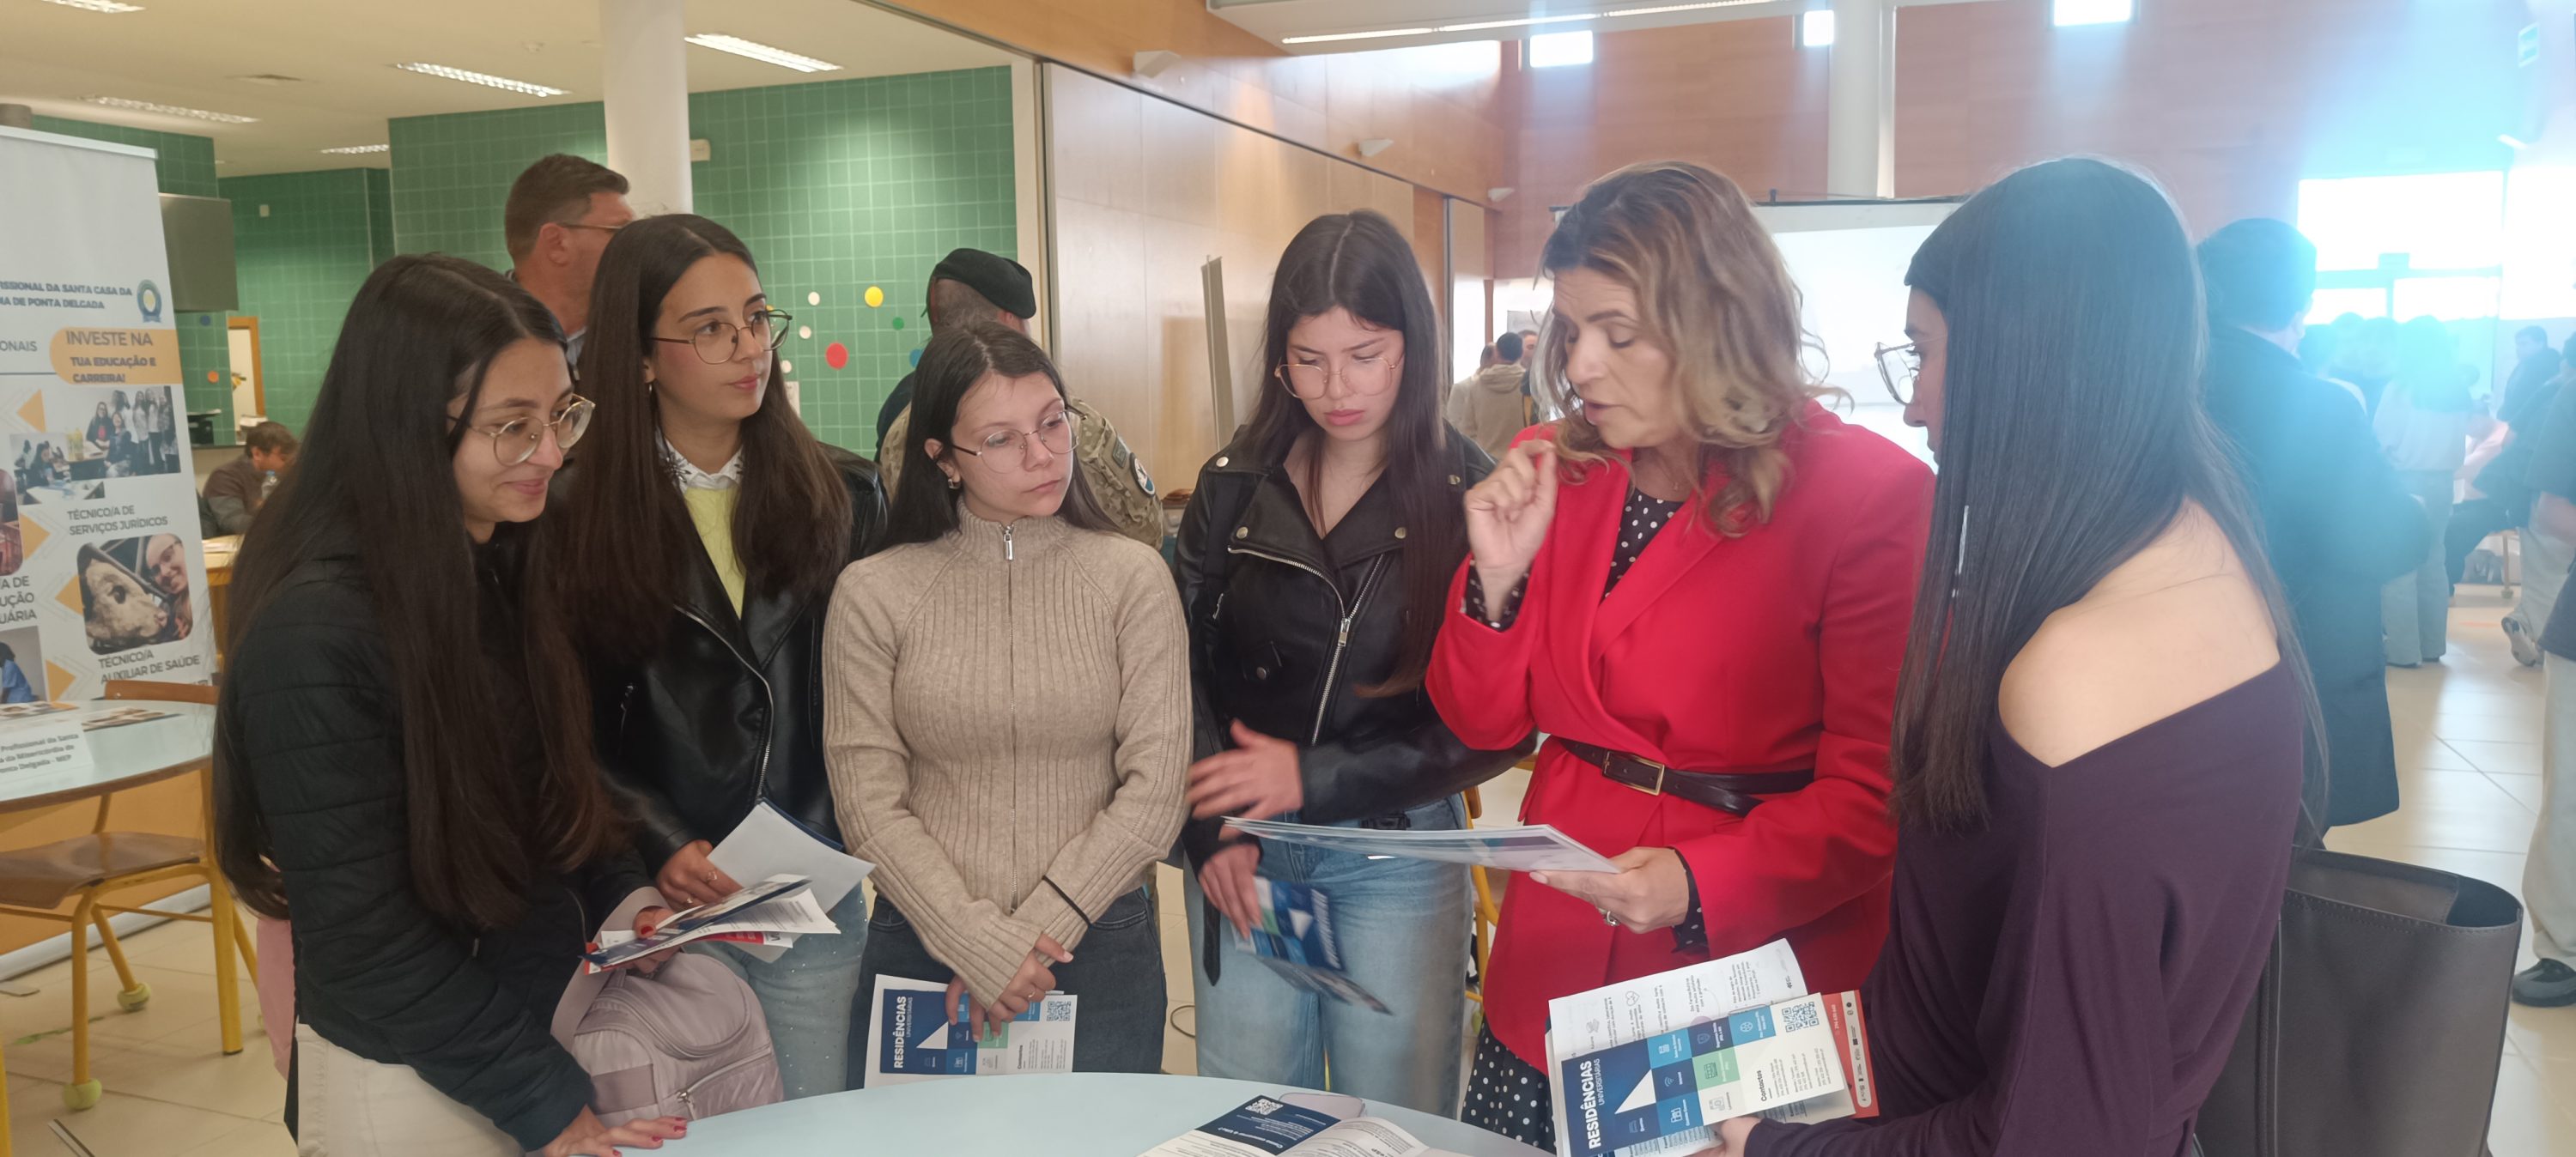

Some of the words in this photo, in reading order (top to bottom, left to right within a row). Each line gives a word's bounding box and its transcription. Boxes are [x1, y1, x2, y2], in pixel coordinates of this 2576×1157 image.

[0, 282, 45, 291] ISSIONAL
[46, 283, 60, 292] DA
[62, 284, 93, 294] SANTA
[94, 286, 118, 295] CASA
[13, 297, 26, 306] DE
[27, 298, 61, 307] PONTA
[63, 300, 105, 309] DELGADA
[66, 331, 127, 346] INVESTE
[131, 332, 153, 346] NA
[70, 357, 92, 366] TUA
[94, 355, 147, 368] EDUCAÇÃO
[149, 358, 156, 366] E
[73, 373, 125, 383] CARREIRA!
[67, 506, 121, 520] TÉCNICO/A
[123, 506, 135, 515] DE
[70, 521, 118, 535] SERVIÇOS
[119, 516, 168, 530] JURÍDICOS
[13, 576, 30, 588] DE
[98, 651, 154, 669] TÉCNICO/A
[149, 662, 163, 674] DE
[165, 655, 201, 671] SAÚDE
[892, 996, 907, 1069] RESIDÊNCIAS
[1593, 1058, 1606, 1106] UNIVERSITÁRIAS
[1756, 1069, 1767, 1101] Contactos
[1579, 1060, 1601, 1149] RESIDÊNCIAS
